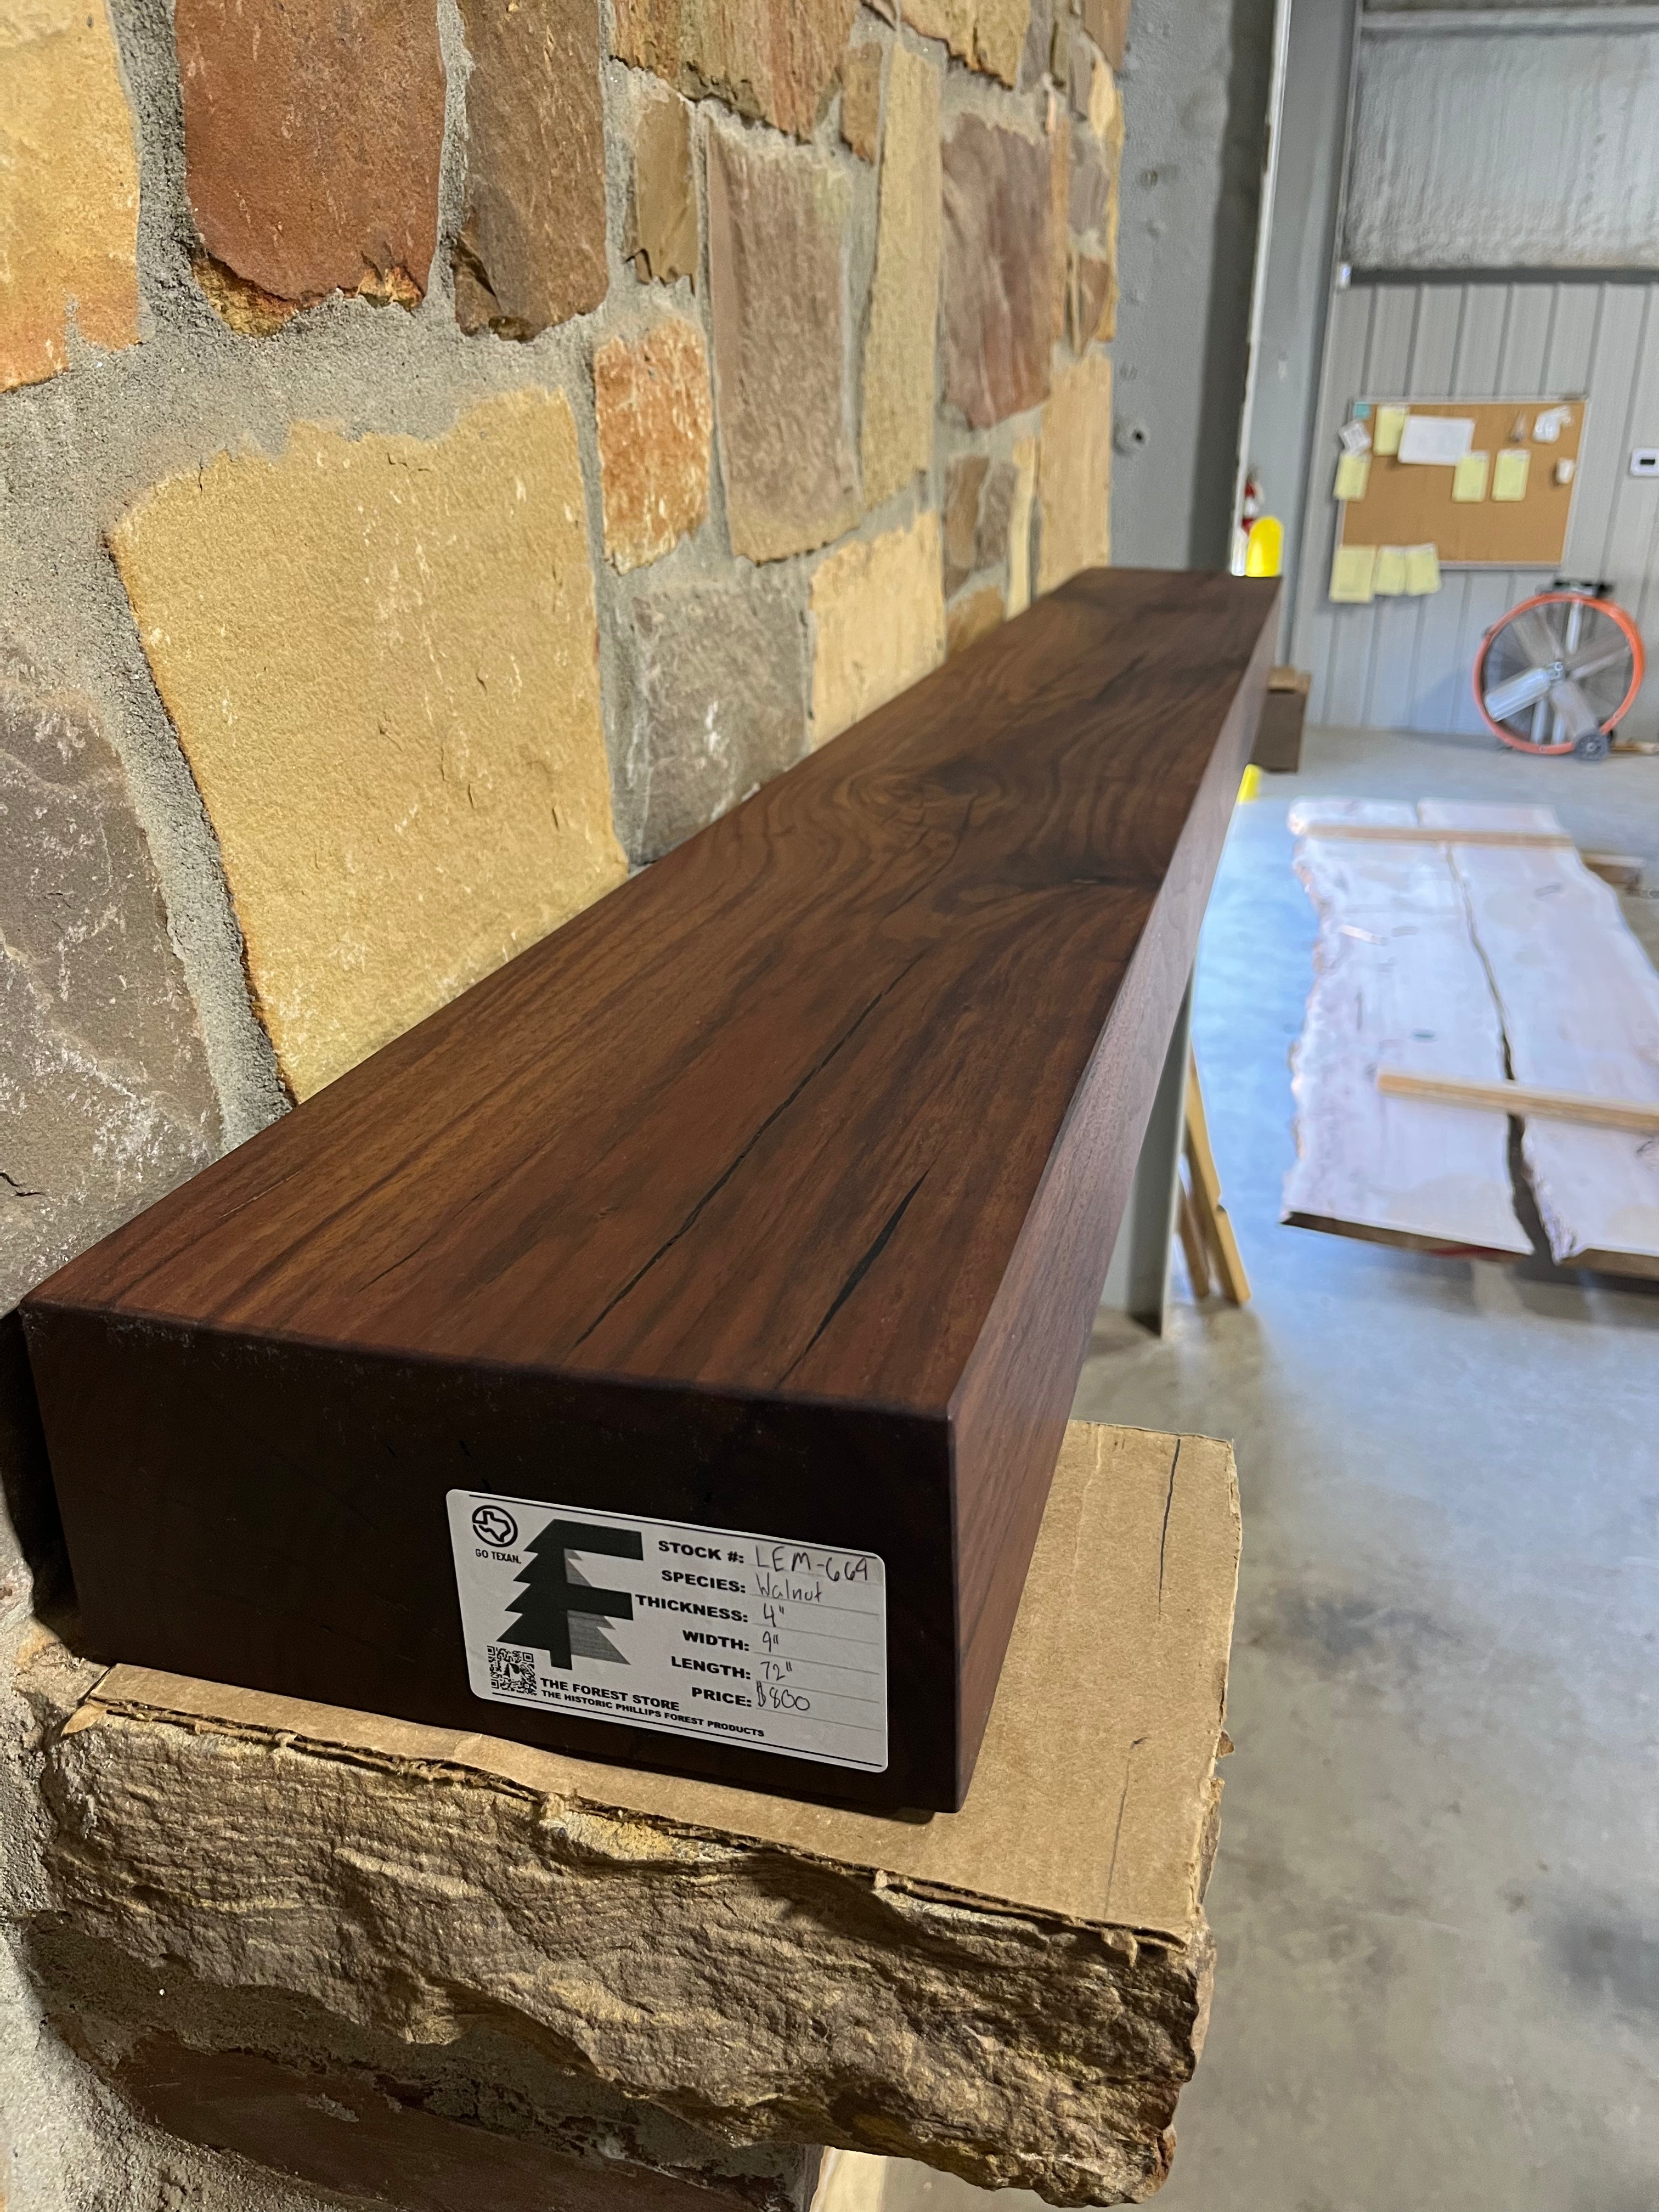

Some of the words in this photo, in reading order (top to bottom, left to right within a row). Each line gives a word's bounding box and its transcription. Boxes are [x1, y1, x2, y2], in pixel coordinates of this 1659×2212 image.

[475, 1548, 489, 1559] GO
[658, 1540, 721, 1560] STOCK
[727, 1551, 744, 1564] #:
[662, 1570, 746, 1593] SPECIES:
[755, 1572, 822, 1602] Walnut
[635, 1594, 748, 1623] THICKNESS:
[763, 1603, 785, 1628] 4"
[682, 1629, 749, 1651] WIDTH:
[762, 1631, 779, 1652] 9"
[671, 1656, 751, 1680] LENGTH:
[760, 1661, 793, 1681] 72"
[540, 1677, 569, 1691] THE
[572, 1683, 628, 1701] FOREST
[632, 1694, 680, 1711] STORE
[691, 1686, 752, 1707] PRICE:
[756, 1680, 810, 1711] $800
[541, 1690, 562, 1700] THE
[564, 1694, 613, 1709] HISTORIC
[615, 1703, 662, 1718] PHILLIPS
[664, 1712, 704, 1725] FOREST
[707, 1720, 765, 1737] PRODUCTS
